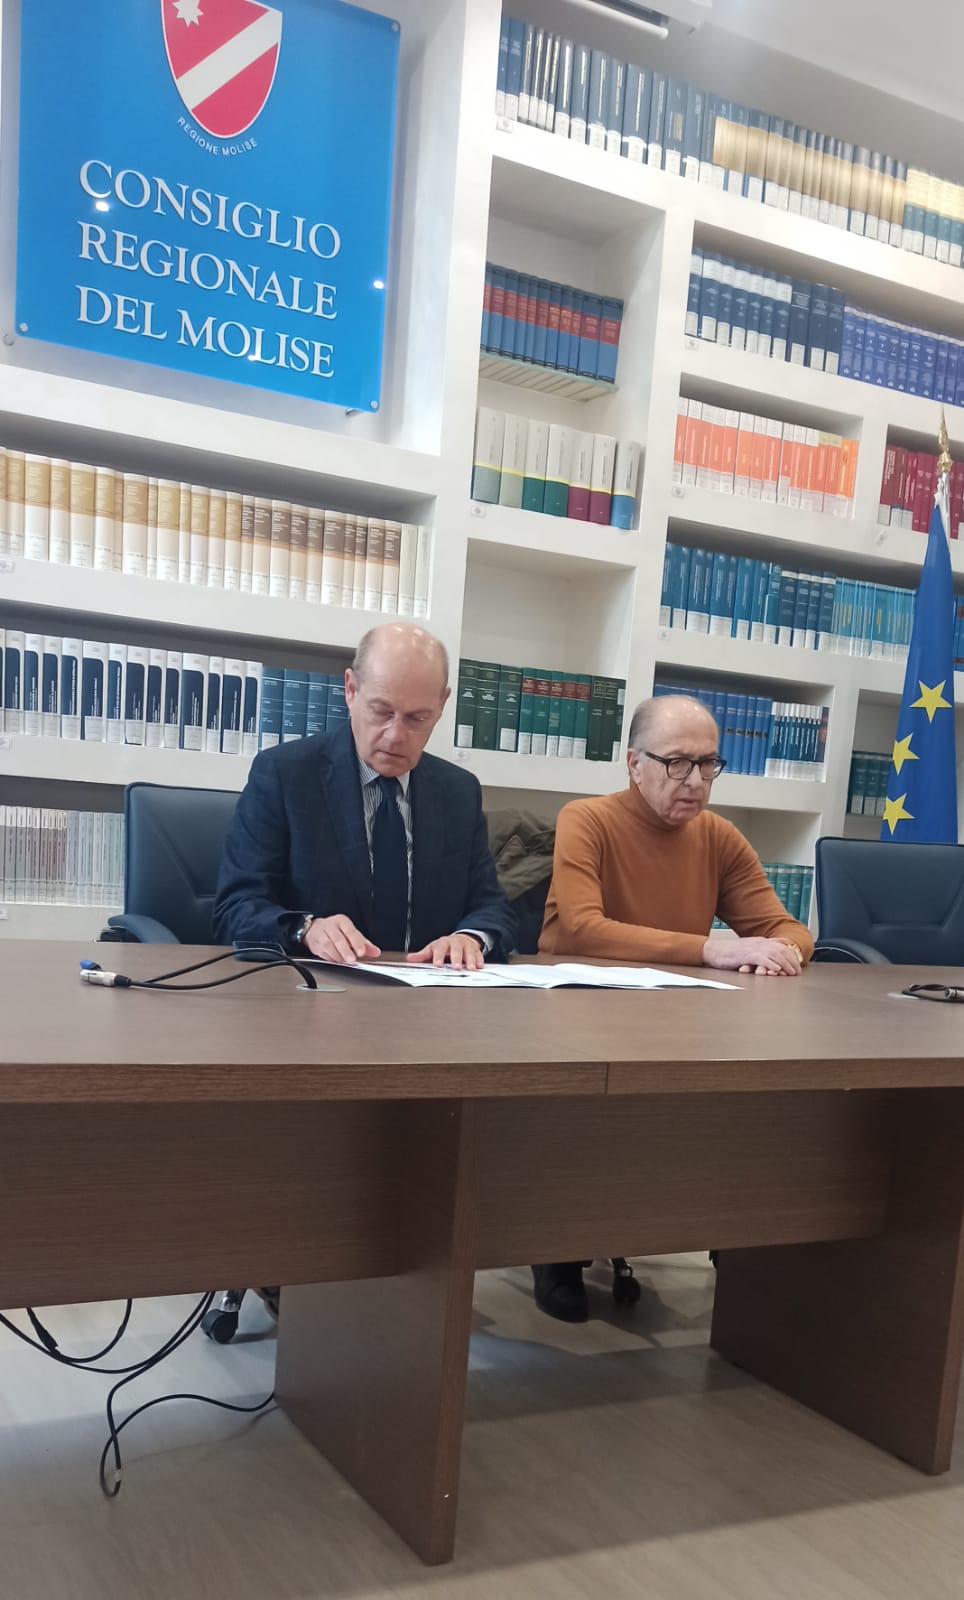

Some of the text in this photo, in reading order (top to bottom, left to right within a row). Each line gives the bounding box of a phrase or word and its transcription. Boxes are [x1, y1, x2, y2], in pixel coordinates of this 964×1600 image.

[177, 116, 258, 156] REGIONE MOLISE
[79, 159, 341, 259] CONSIGLIO
[77, 221, 338, 320] REGIONALE
[75, 284, 335, 378] DEL MOLISE
